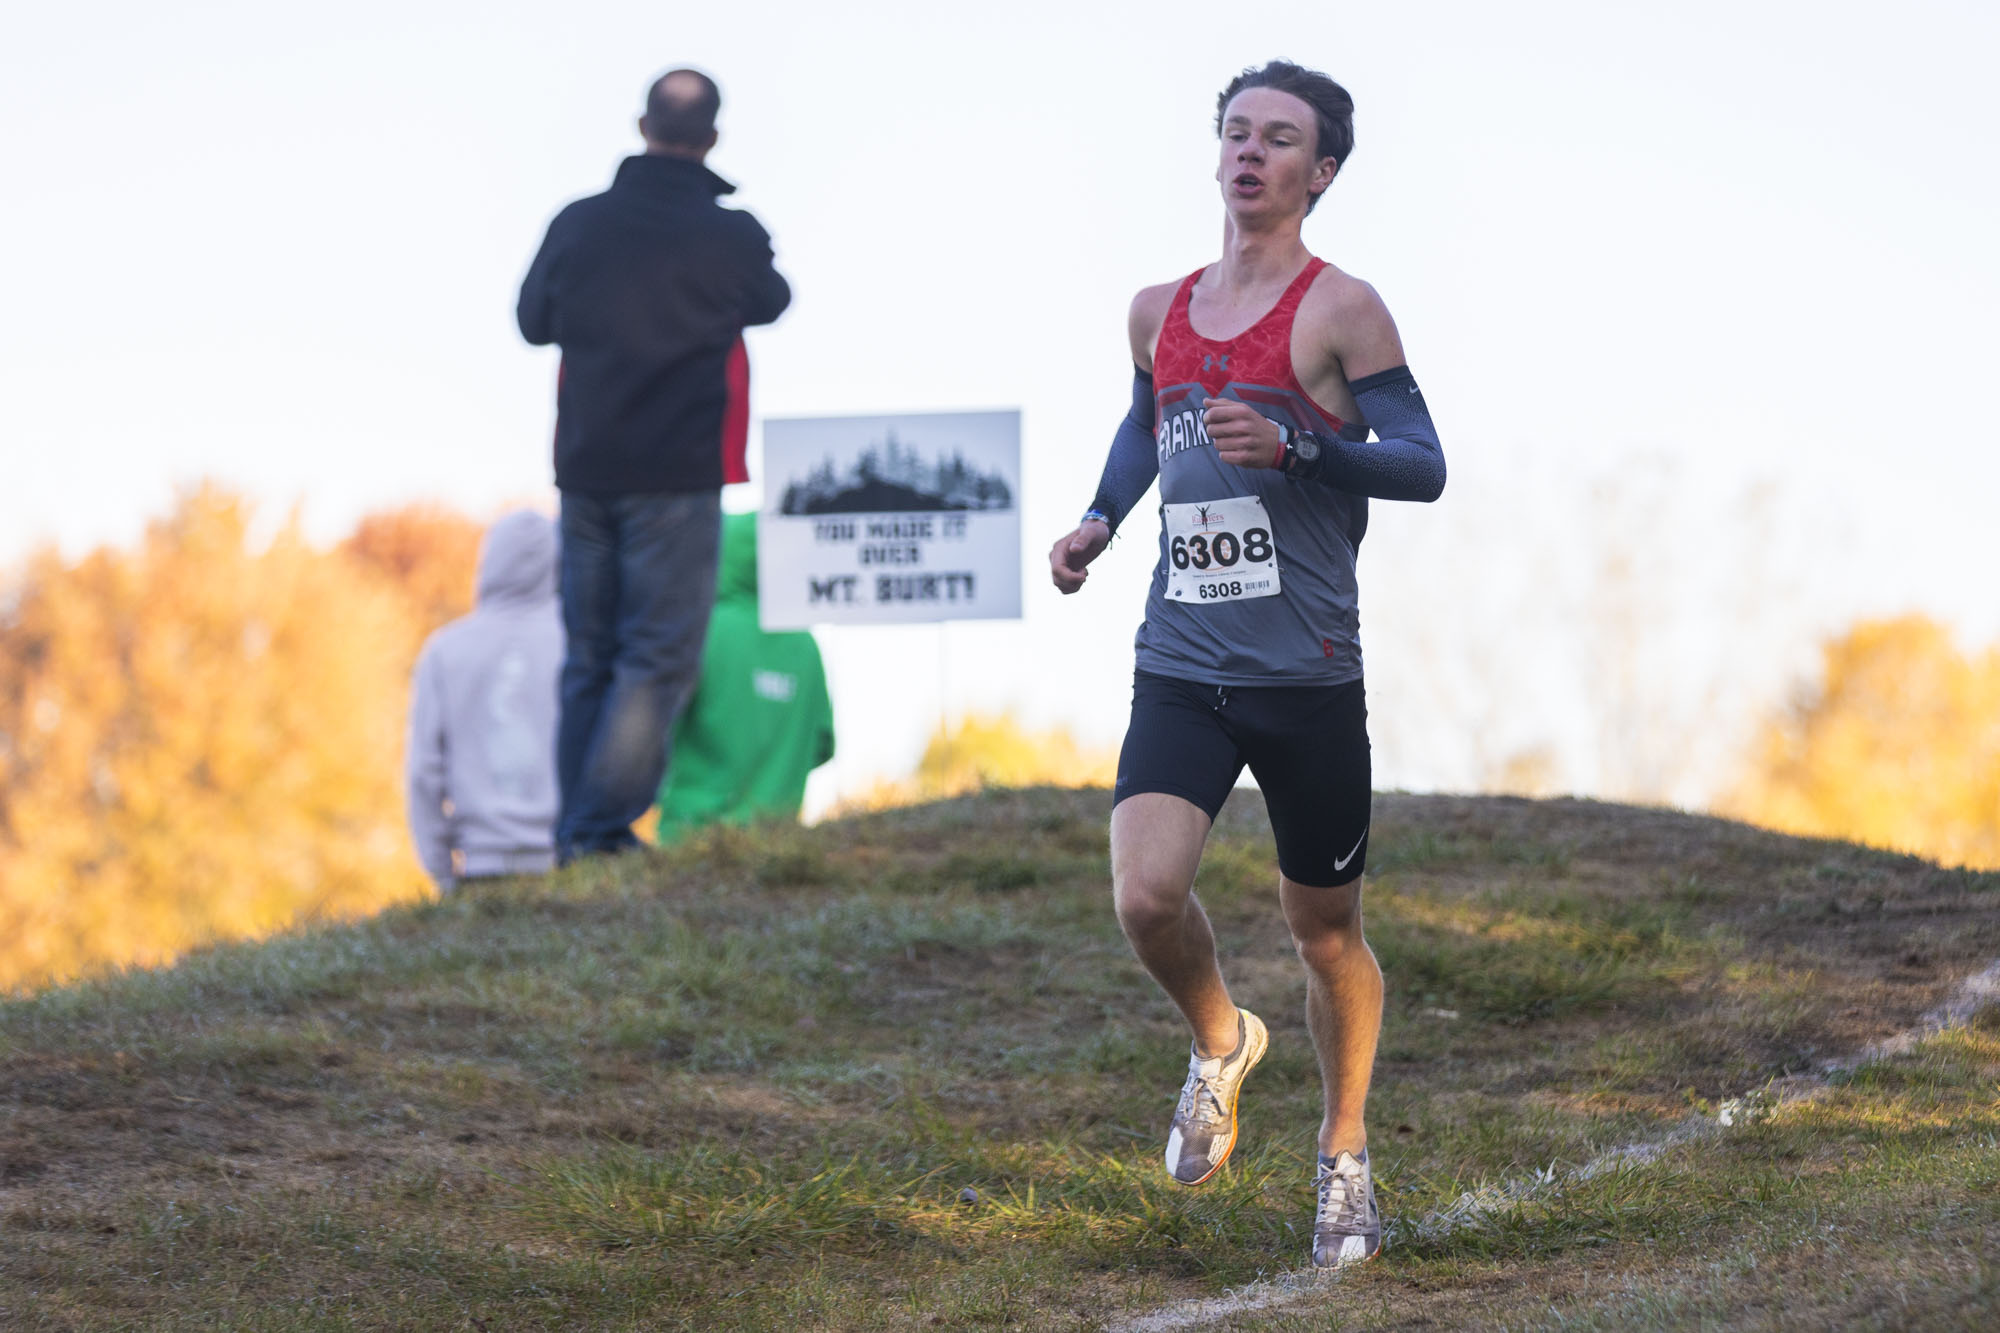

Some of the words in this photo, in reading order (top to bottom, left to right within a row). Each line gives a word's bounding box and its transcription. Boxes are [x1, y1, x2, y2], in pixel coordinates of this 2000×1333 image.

[1158, 407, 1213, 461] FRANK
[813, 516, 856, 541] YOU
[865, 515, 934, 540] MADE
[859, 543, 919, 565] OVER
[1170, 527, 1273, 570] 6308
[1199, 581, 1242, 599] 6308
